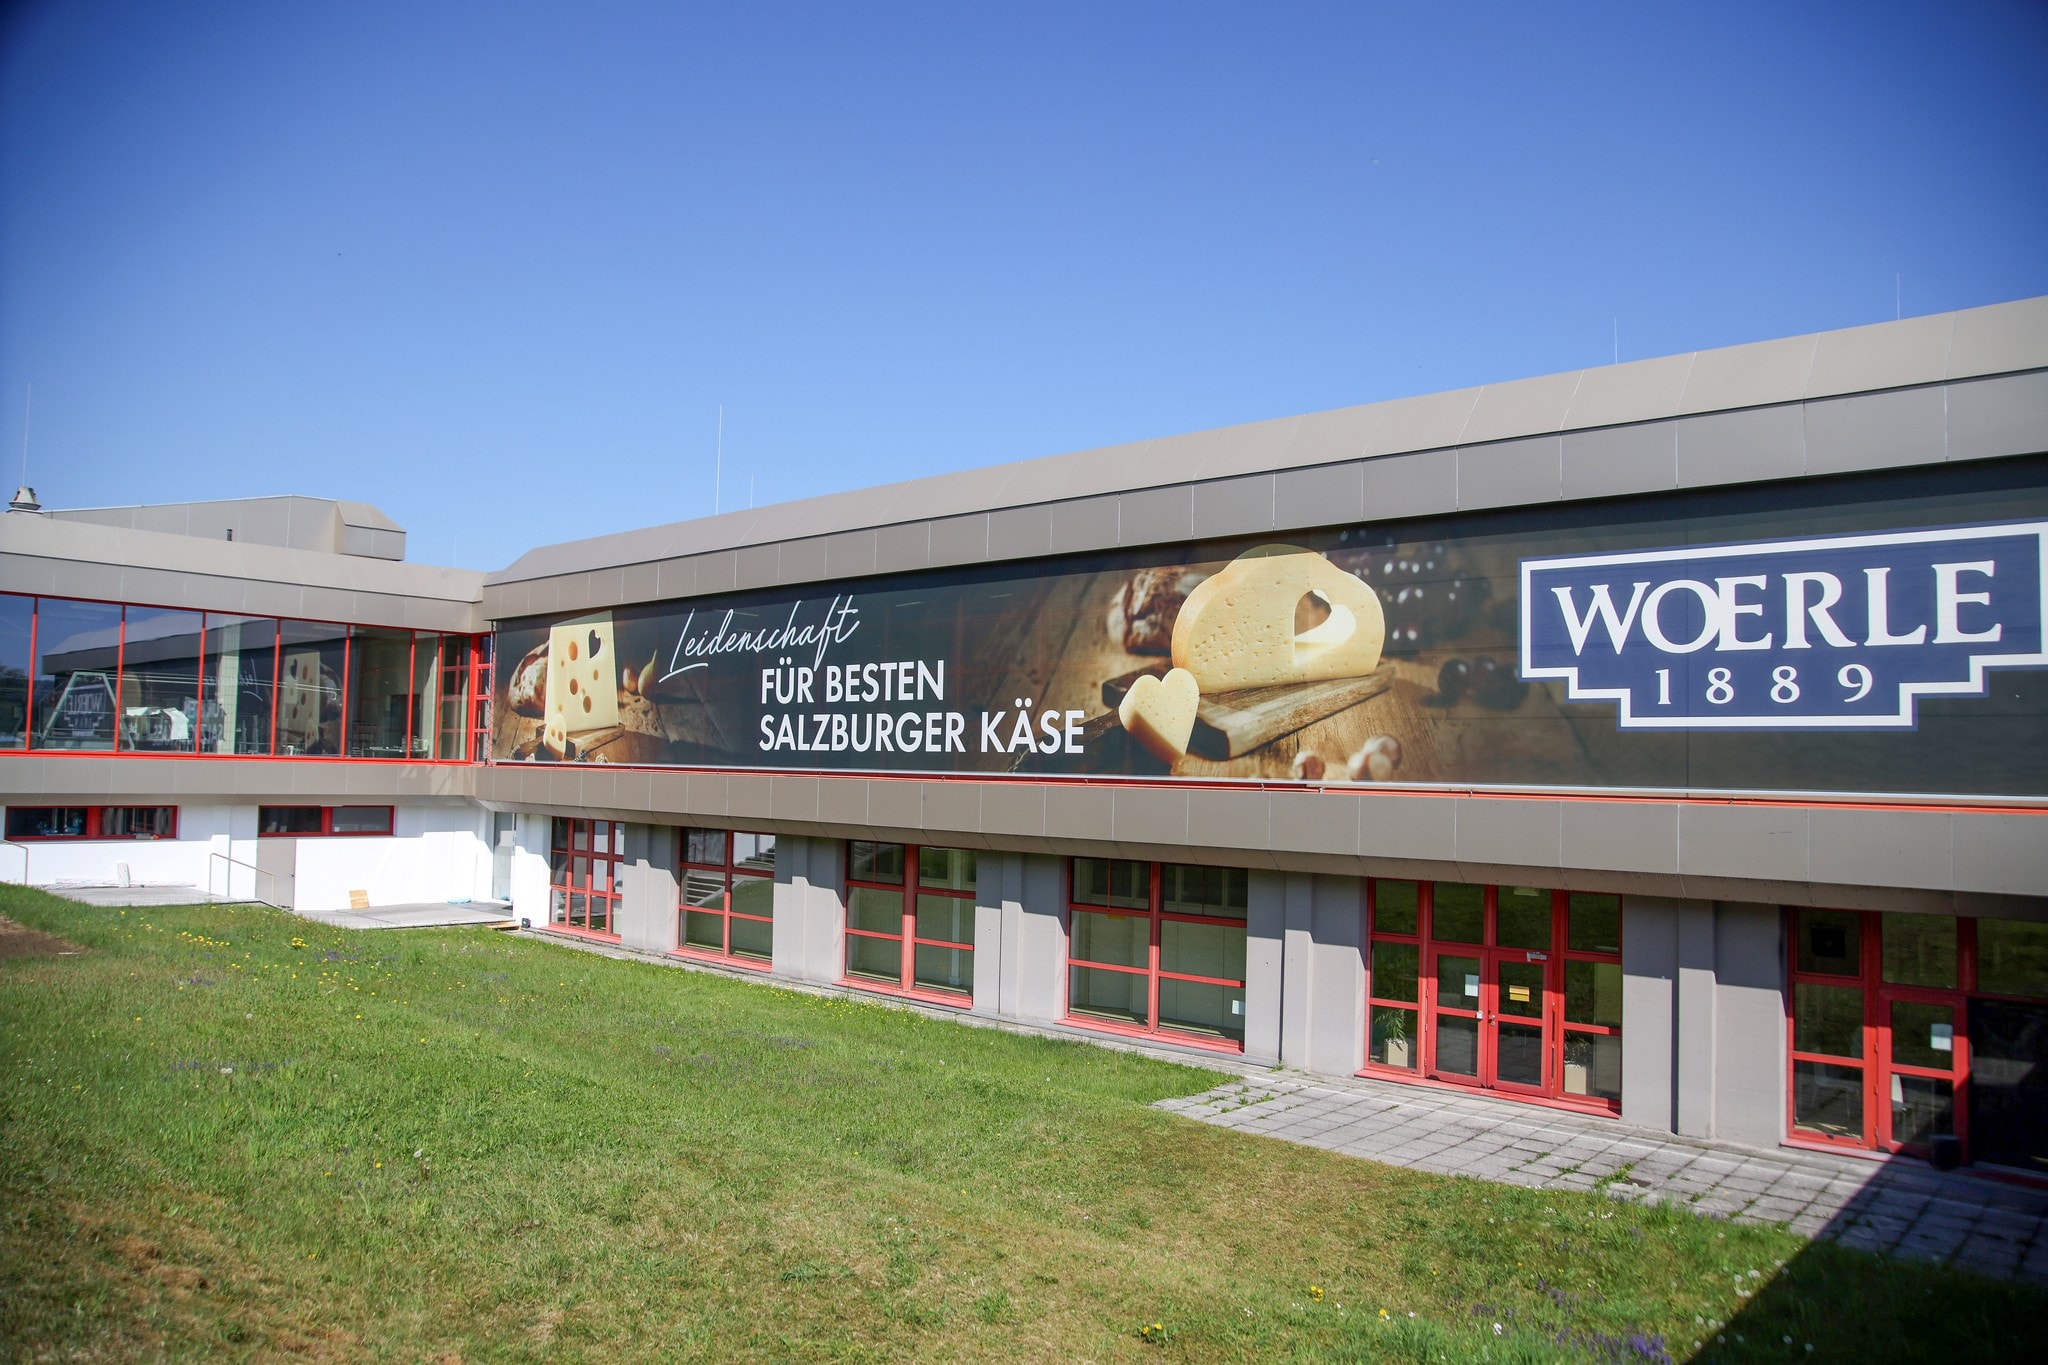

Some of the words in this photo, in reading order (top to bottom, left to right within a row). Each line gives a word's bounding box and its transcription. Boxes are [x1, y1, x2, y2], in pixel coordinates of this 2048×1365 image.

[1551, 560, 2002, 656] WOERLE
[658, 594, 860, 683] Leidenschaft
[761, 656, 815, 704] FÜR
[826, 659, 945, 703] BESTEN
[1655, 663, 1873, 705] 1889
[759, 710, 966, 752] SALZBURGER
[980, 697, 1085, 754] KÄSE
